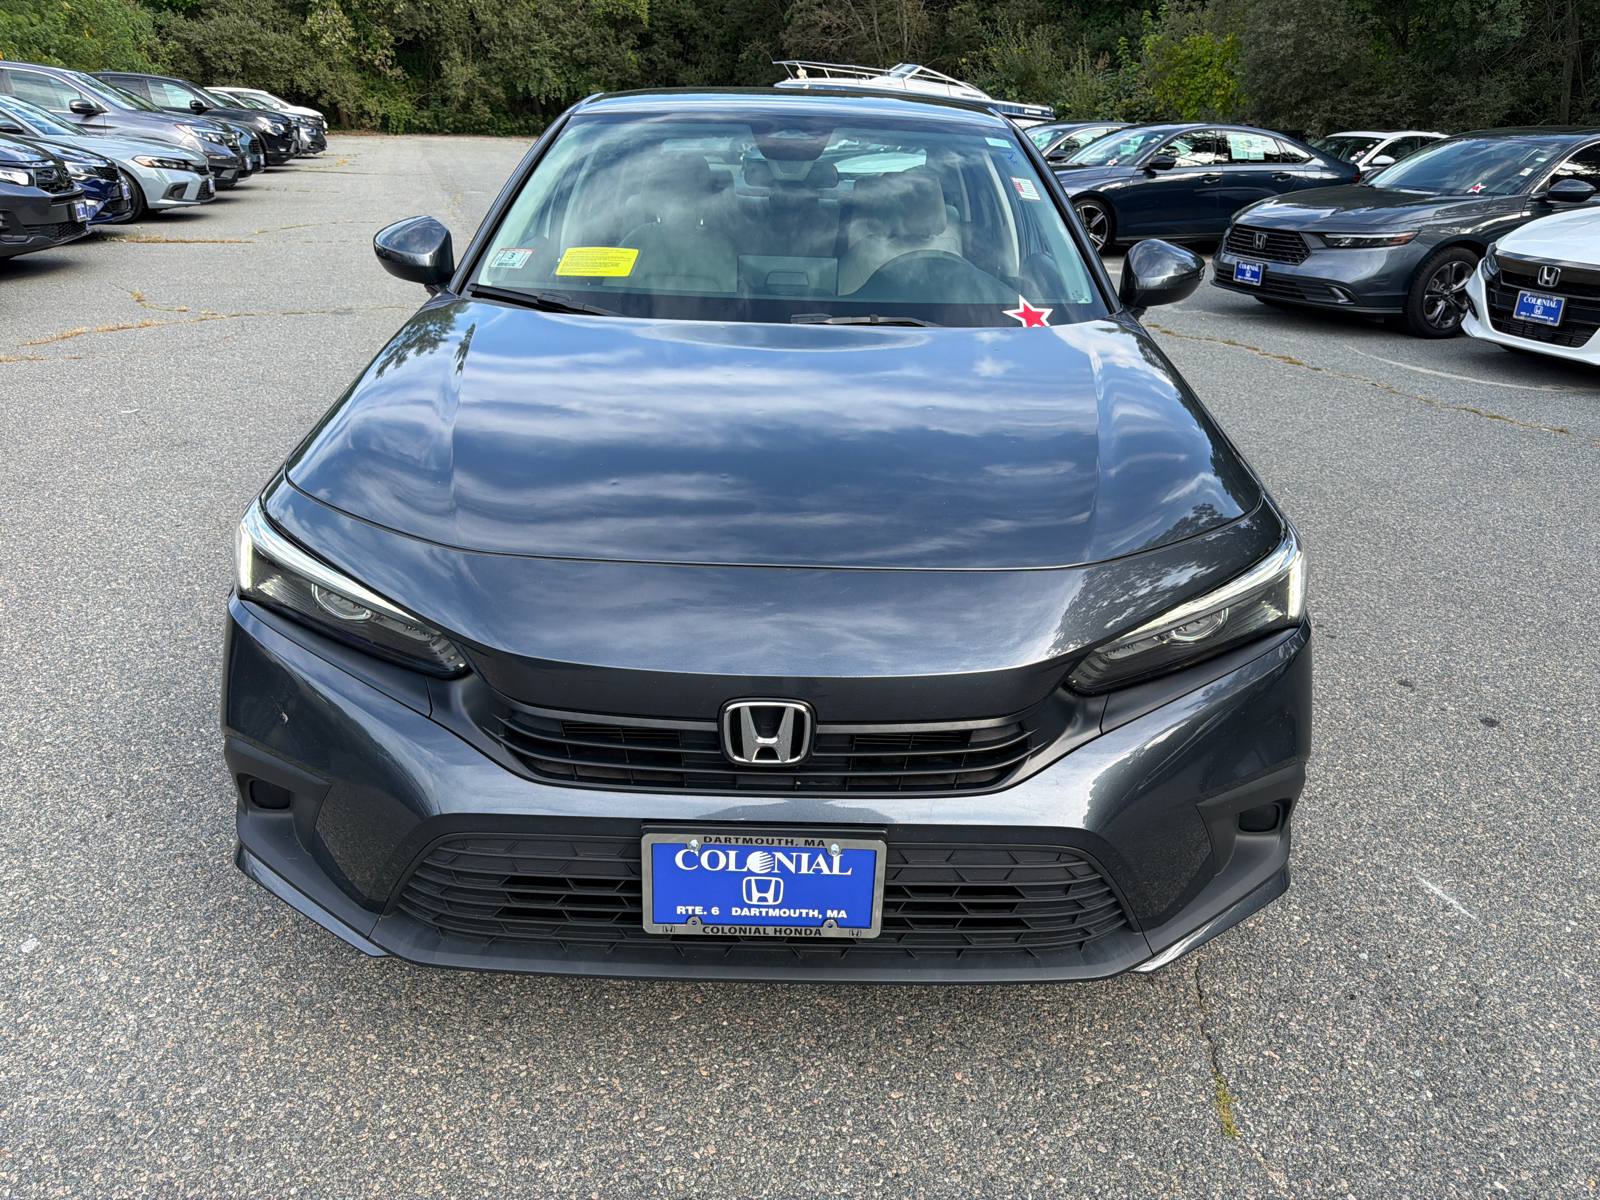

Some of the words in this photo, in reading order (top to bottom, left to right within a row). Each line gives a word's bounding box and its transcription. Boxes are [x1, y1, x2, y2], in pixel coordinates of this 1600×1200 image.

[1523, 295, 1557, 308] COLONIAL
[703, 835, 799, 847] DARTMOUTH,
[804, 838, 826, 847] MA
[674, 849, 853, 876] COLONIAL
[676, 905, 708, 916] RTE.
[710, 906, 720, 916] 6
[731, 907, 823, 919] DARTMOUTH,
[826, 909, 848, 919] MA
[702, 925, 771, 936] COLONIAL
[773, 927, 822, 937] HONDA
